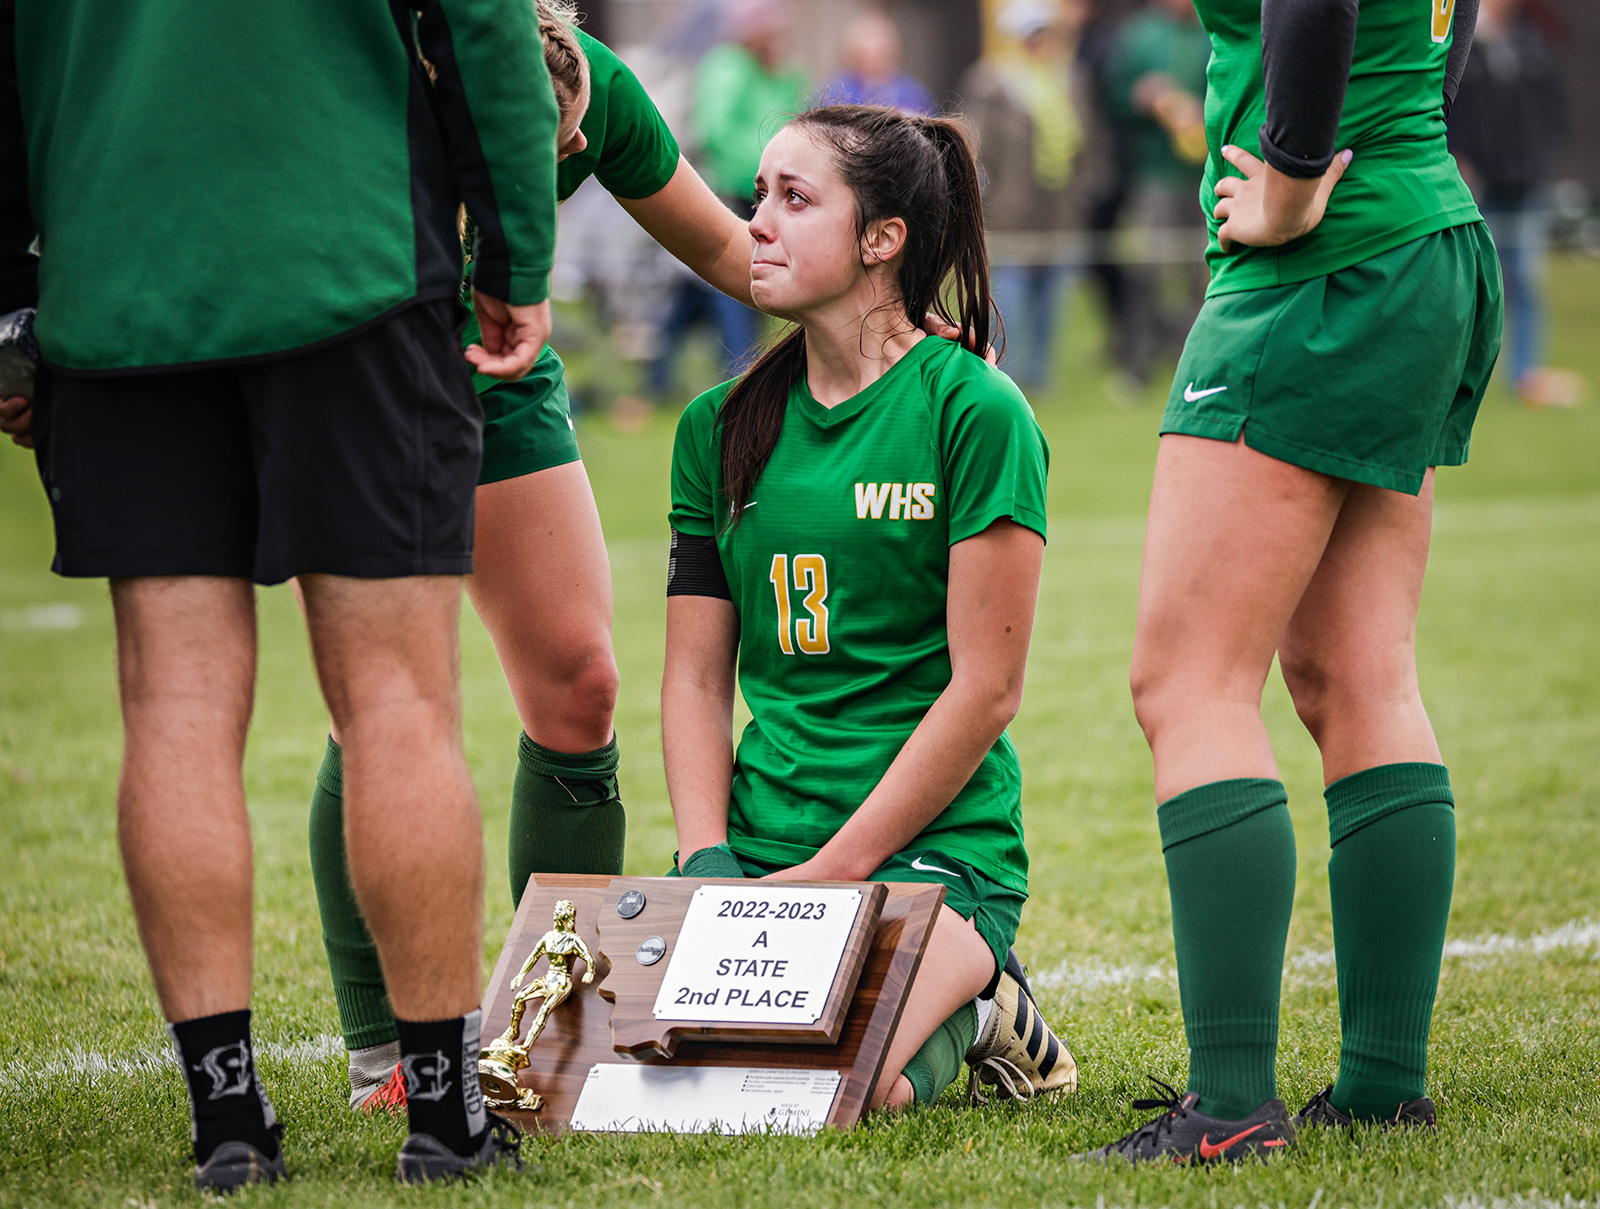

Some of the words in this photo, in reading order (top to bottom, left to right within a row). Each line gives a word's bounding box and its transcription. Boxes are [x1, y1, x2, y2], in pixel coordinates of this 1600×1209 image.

[854, 482, 936, 520] WHS
[769, 554, 830, 655] 13
[717, 900, 827, 920] 2022-2023
[751, 930, 769, 948] A
[716, 958, 789, 978] STATE
[674, 987, 720, 1006] 2nd
[724, 988, 809, 1008] PLACE
[463, 1038, 482, 1115] LEGEND
